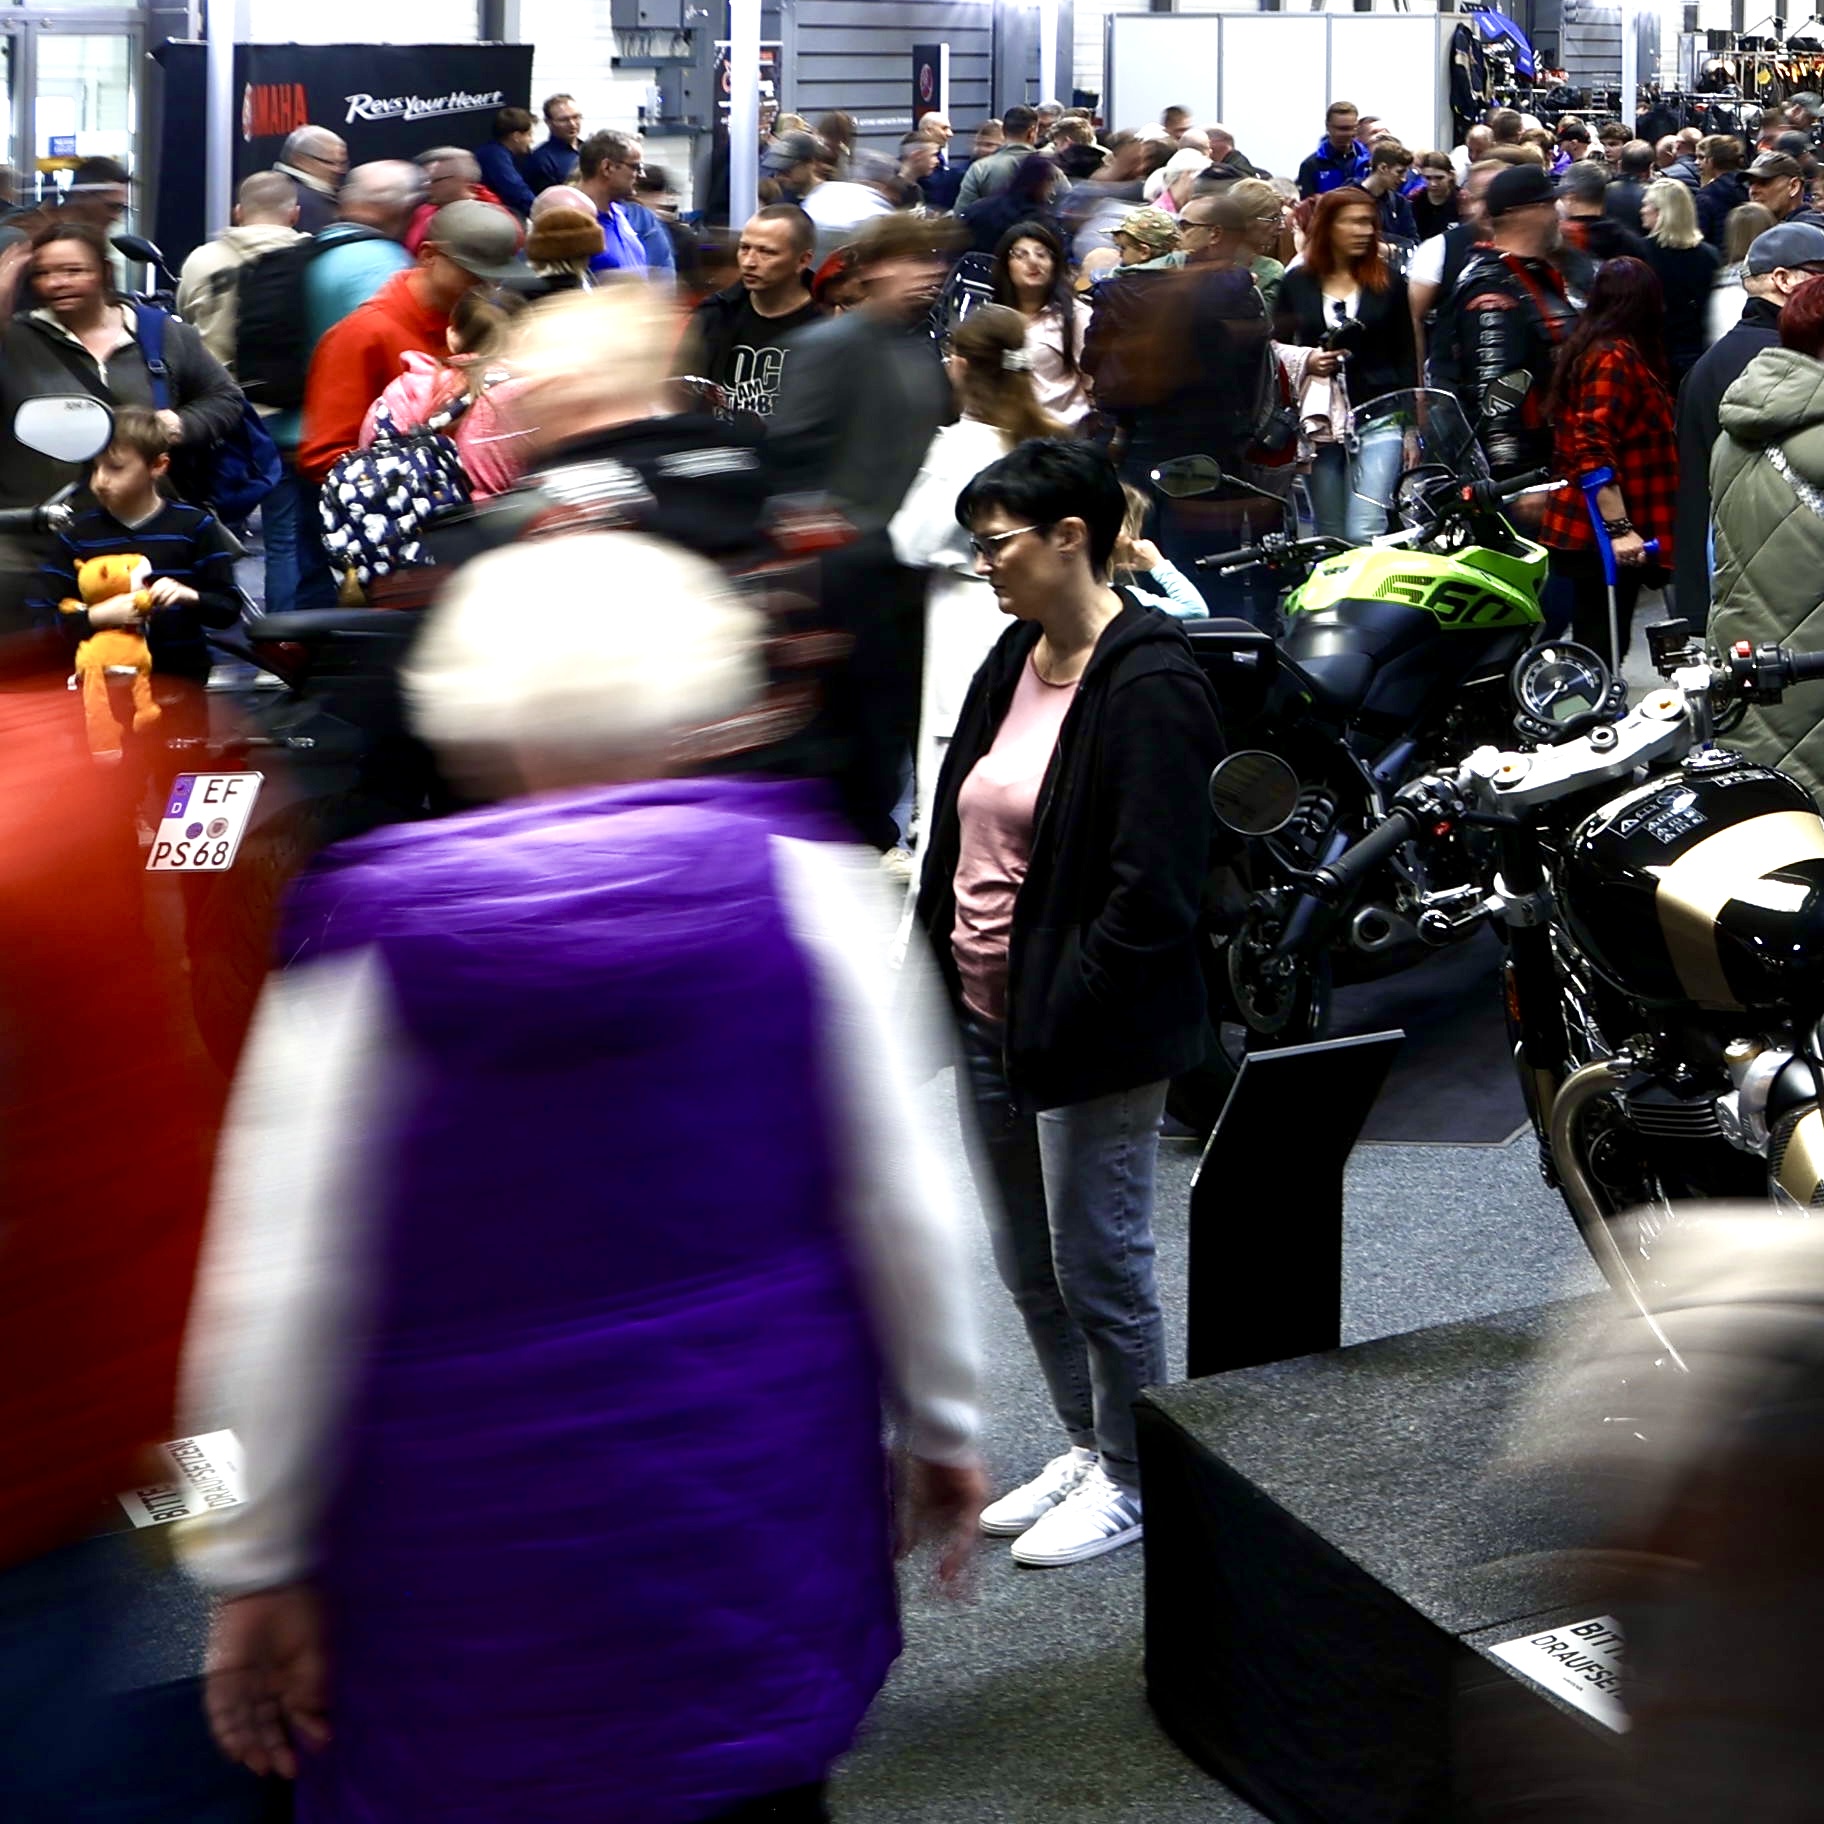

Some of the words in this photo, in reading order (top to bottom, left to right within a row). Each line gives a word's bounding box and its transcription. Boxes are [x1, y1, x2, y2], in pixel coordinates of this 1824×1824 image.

[203, 778, 244, 805] EF
[171, 801, 183, 816] D
[1570, 1622, 1625, 1662] BITT
